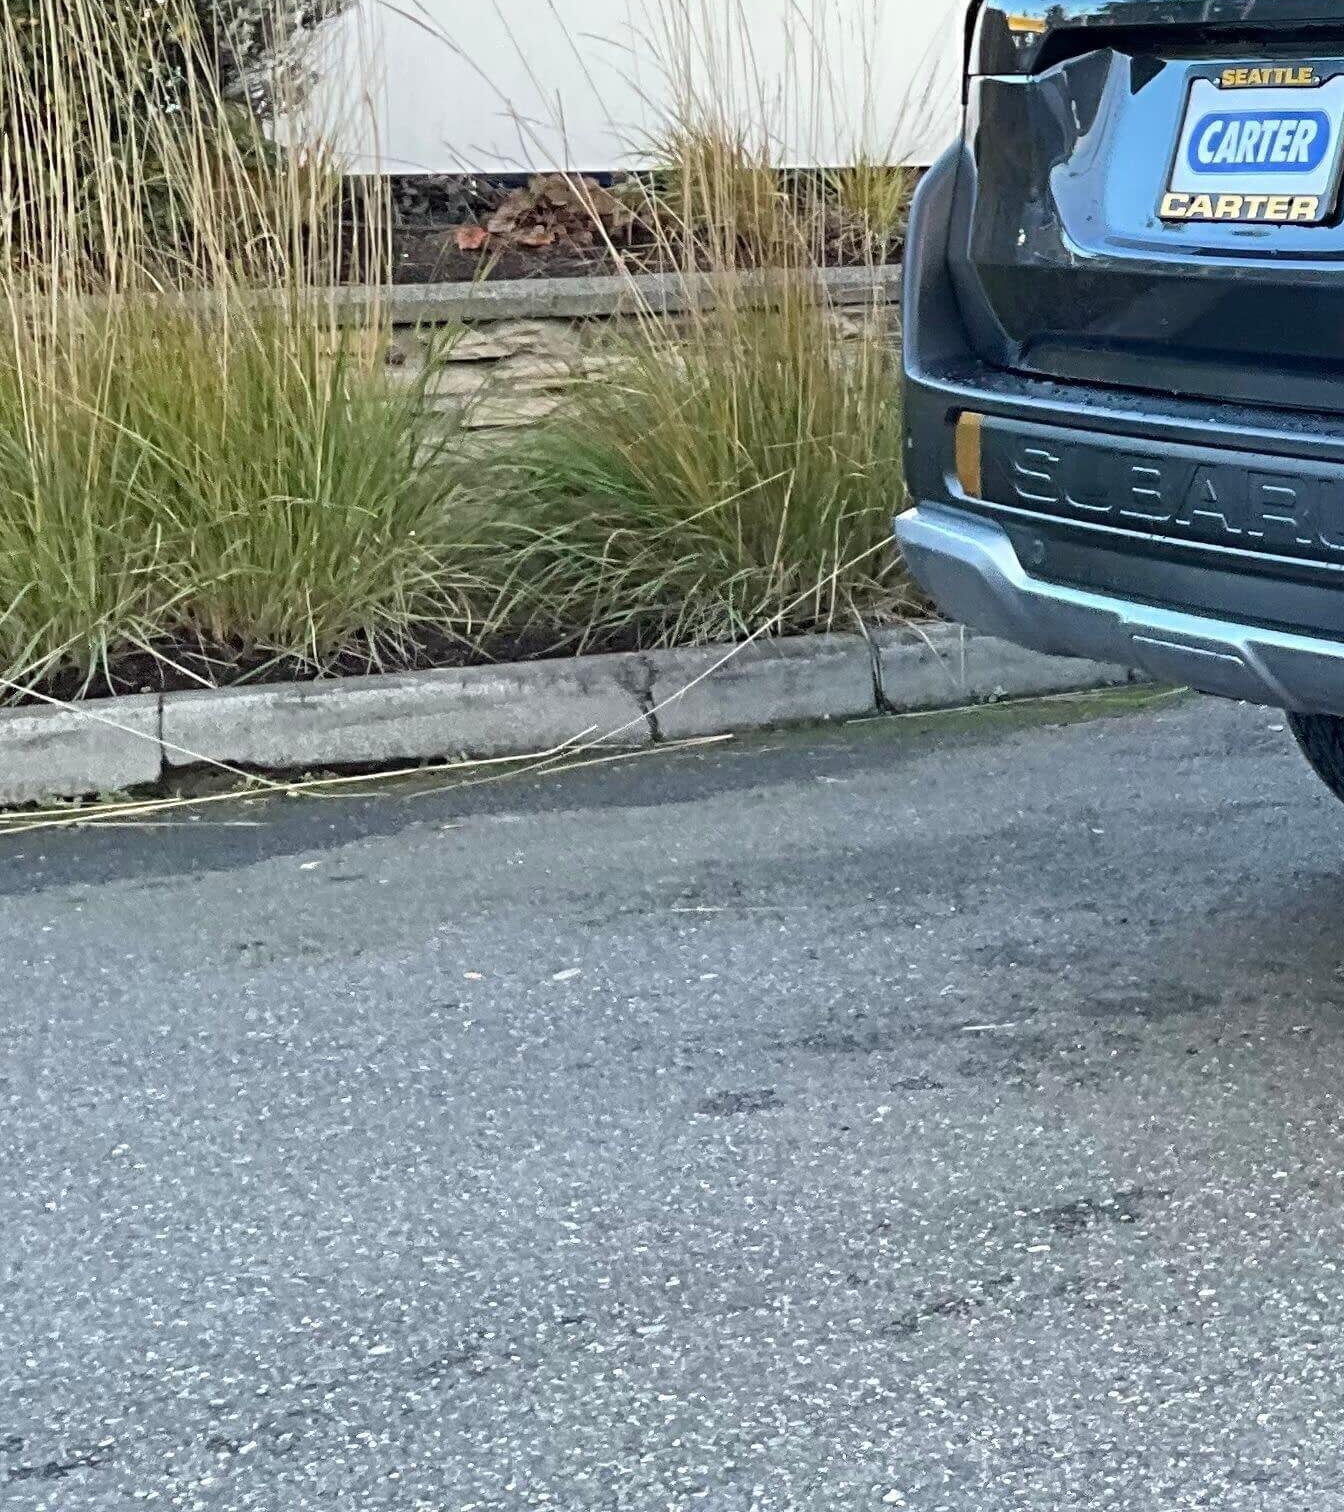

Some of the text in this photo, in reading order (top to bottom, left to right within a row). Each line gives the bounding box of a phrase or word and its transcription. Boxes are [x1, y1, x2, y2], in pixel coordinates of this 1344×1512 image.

[1220, 67, 1313, 86] SEATTLE
[1197, 119, 1319, 164] CARTER
[1159, 192, 1319, 221] CARTER
